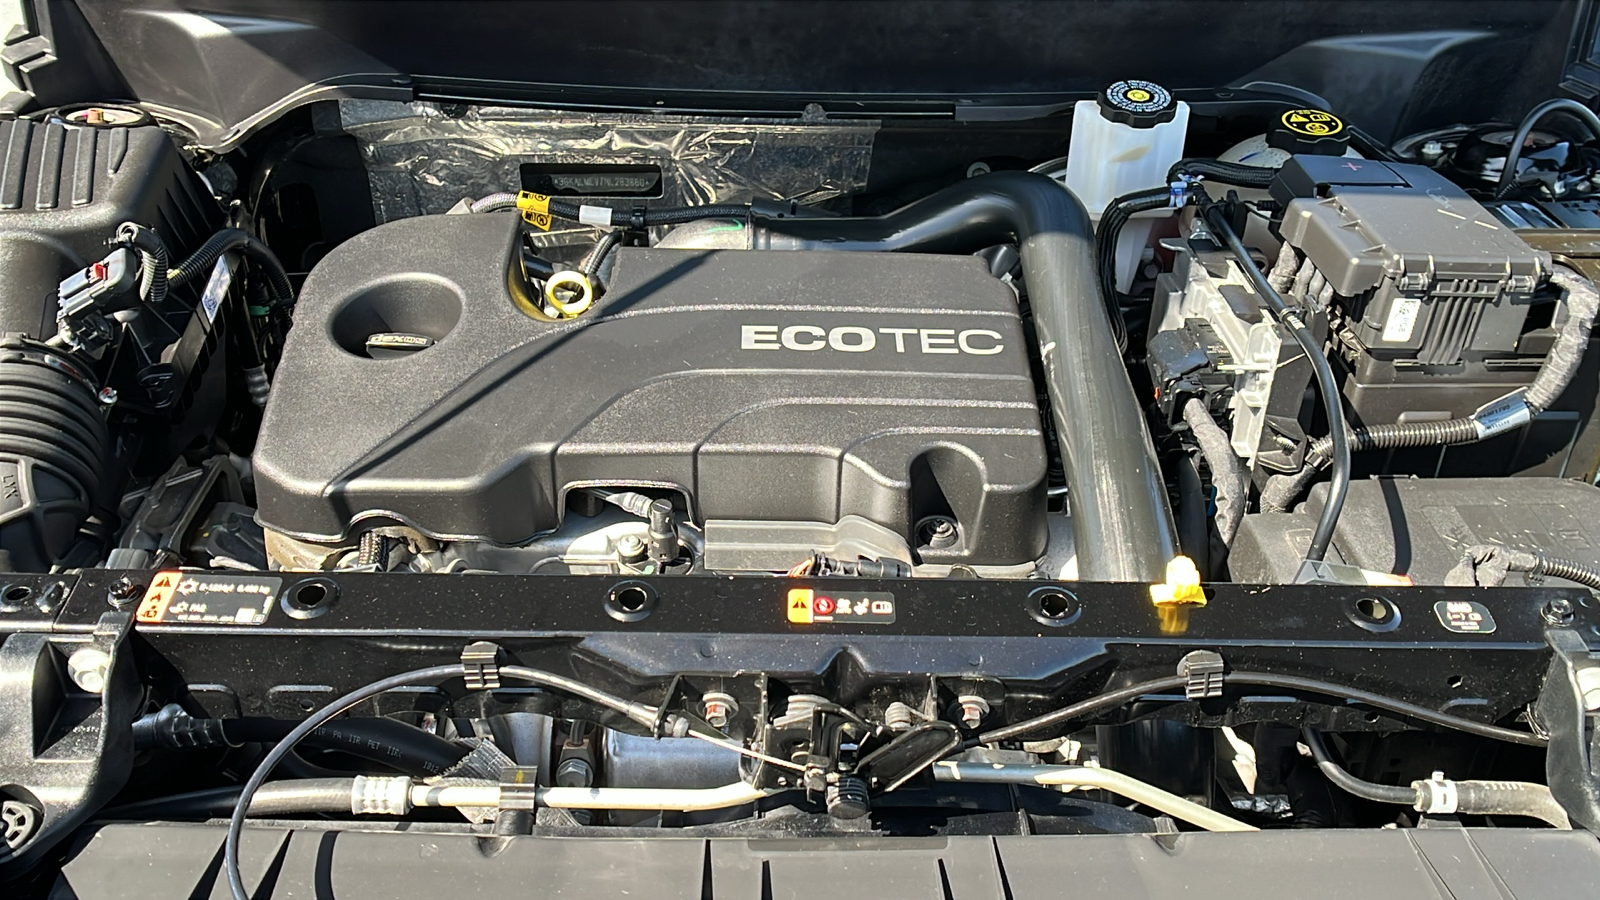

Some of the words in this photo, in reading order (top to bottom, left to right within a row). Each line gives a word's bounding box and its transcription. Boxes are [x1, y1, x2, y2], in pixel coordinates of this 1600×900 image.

[371, 334, 427, 345] dexos
[740, 324, 1005, 356] ECOTEC
[332, 730, 342, 740] PA
[366, 739, 380, 750] PET
